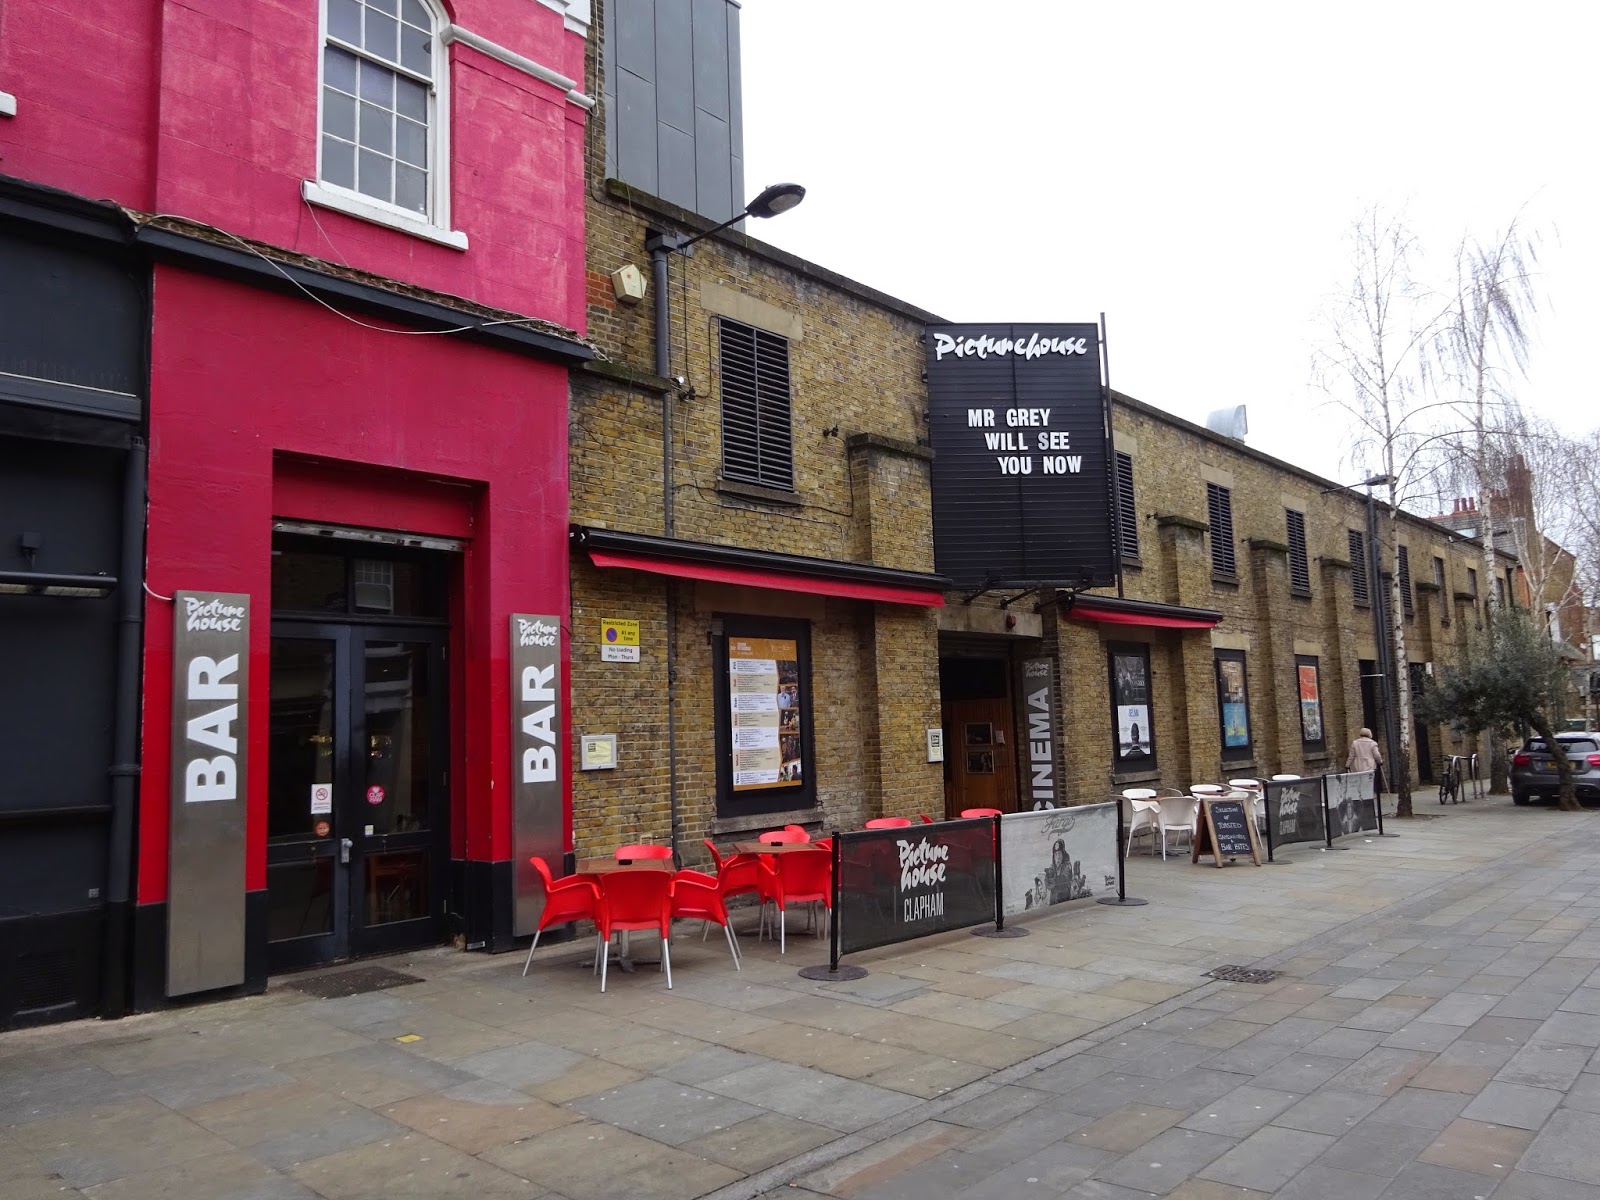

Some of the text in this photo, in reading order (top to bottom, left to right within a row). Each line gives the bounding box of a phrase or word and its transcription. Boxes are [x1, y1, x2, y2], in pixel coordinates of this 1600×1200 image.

[933, 333, 1087, 361] Picturehouse
[968, 408, 1051, 427] MR GREY
[984, 432, 1070, 451] WILL SEE
[997, 456, 1082, 475] YOU NOW
[184, 597, 245, 618] Picture
[186, 613, 241, 632] house
[517, 618, 558, 636] Picture
[520, 632, 556, 647] house
[185, 653, 239, 803] BAR
[521, 663, 557, 783] BAR
[896, 836, 949, 868] Picture
[901, 859, 946, 893] house
[904, 892, 944, 922] CLAPHAM
